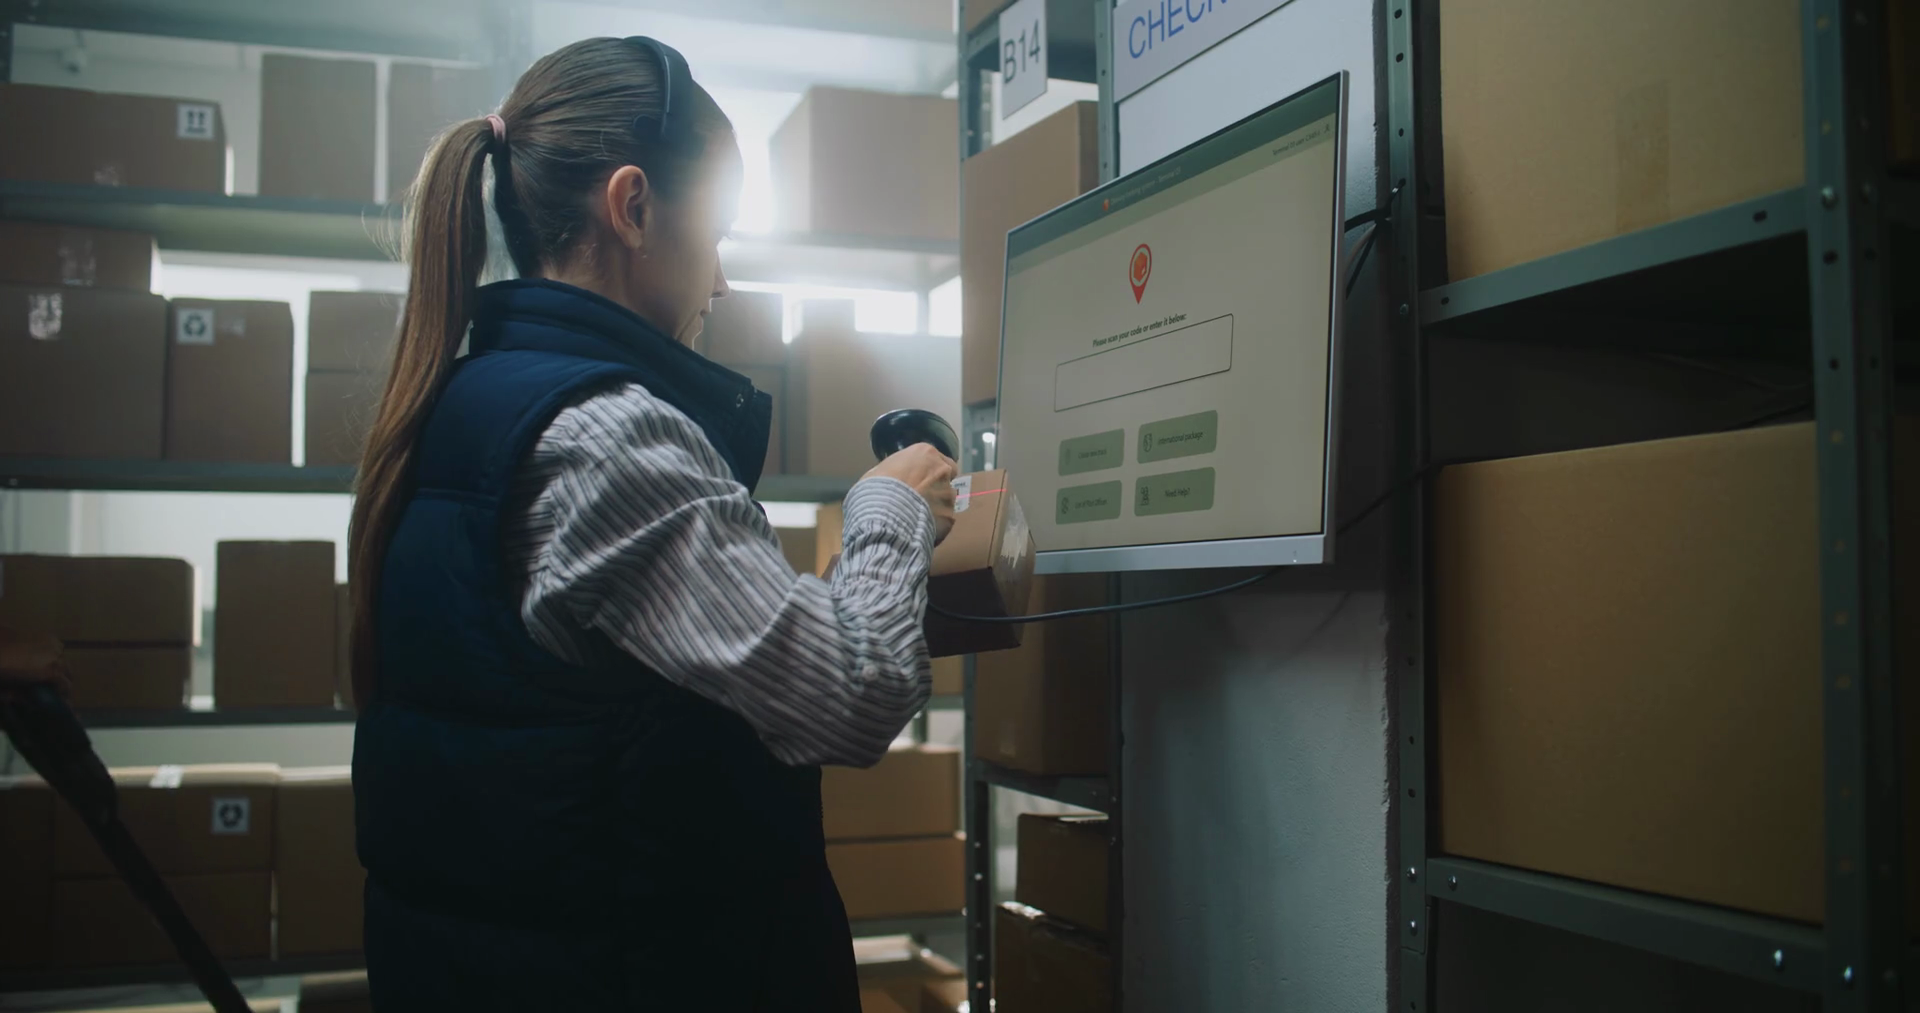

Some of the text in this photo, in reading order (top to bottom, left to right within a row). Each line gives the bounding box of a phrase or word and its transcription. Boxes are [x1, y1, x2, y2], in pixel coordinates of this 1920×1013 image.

[1003, 19, 1041, 84] B14
[1129, 0, 1227, 59] CHEC
[1092, 337, 1107, 348] Please
[1107, 334, 1118, 344] scan
[1118, 331, 1130, 342] your
[1130, 325, 1142, 337] code
[1149, 320, 1163, 331] enter
[1168, 312, 1187, 325] below:
